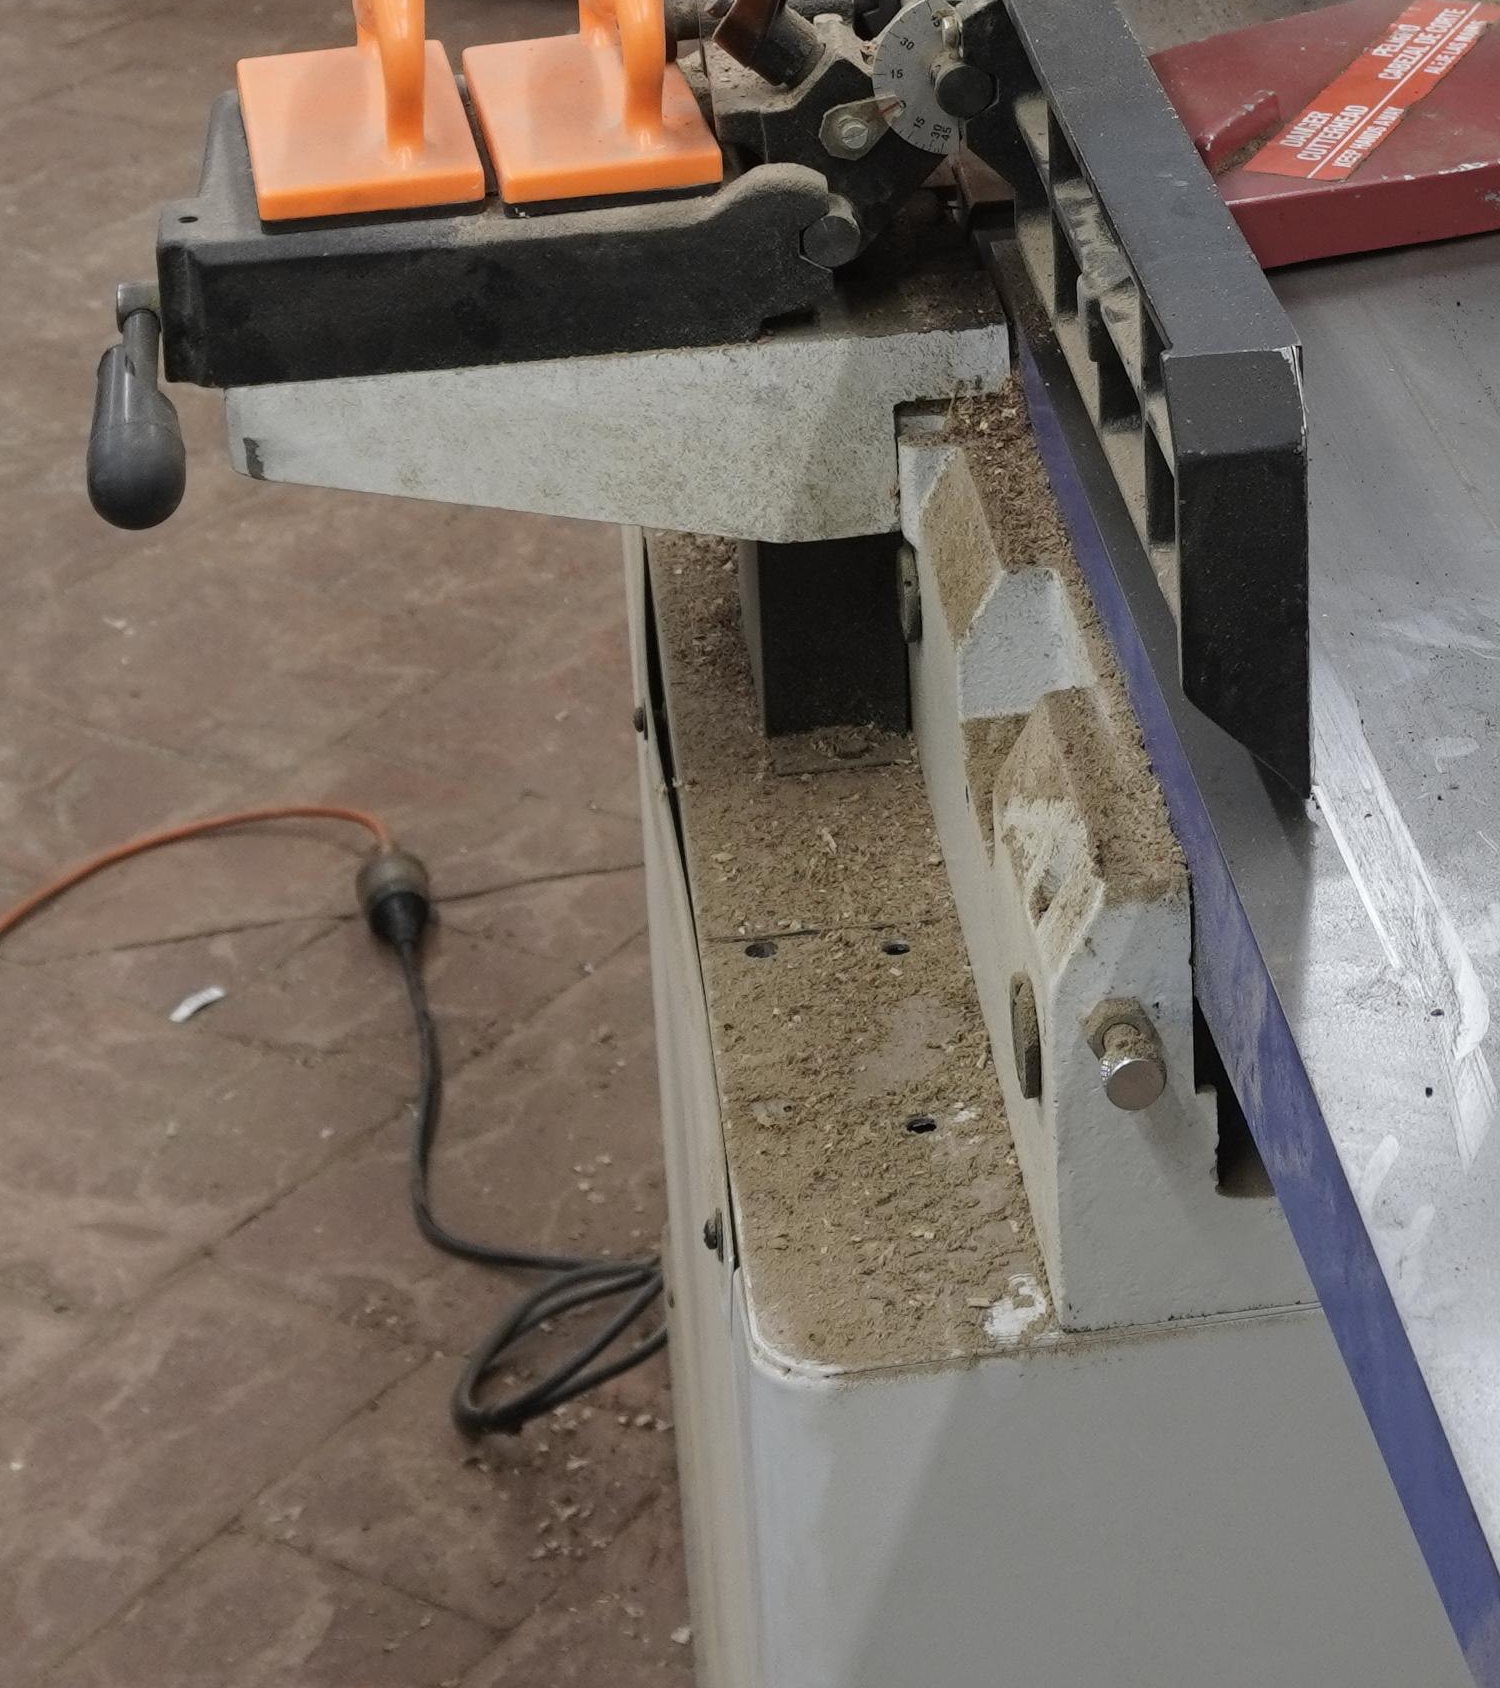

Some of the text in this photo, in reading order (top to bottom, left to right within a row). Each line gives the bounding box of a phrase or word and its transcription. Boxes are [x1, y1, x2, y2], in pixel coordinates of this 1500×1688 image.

[900, 37, 915, 51] 30
[1372, 23, 1421, 57] PELIGRO
[1378, 8, 1467, 79] CABEZAL DE CORTE
[1441, 42, 1468, 55] LAS
[890, 68, 904, 79] 15
[912, 116, 926, 130] 15
[930, 123, 943, 139] 30
[1279, 110, 1333, 148] DANGER
[941, 126, 952, 142] 45
[1296, 104, 1370, 161] CUTTERHEAD
[1332, 105, 1405, 168] KEEP HANDS AWAY
